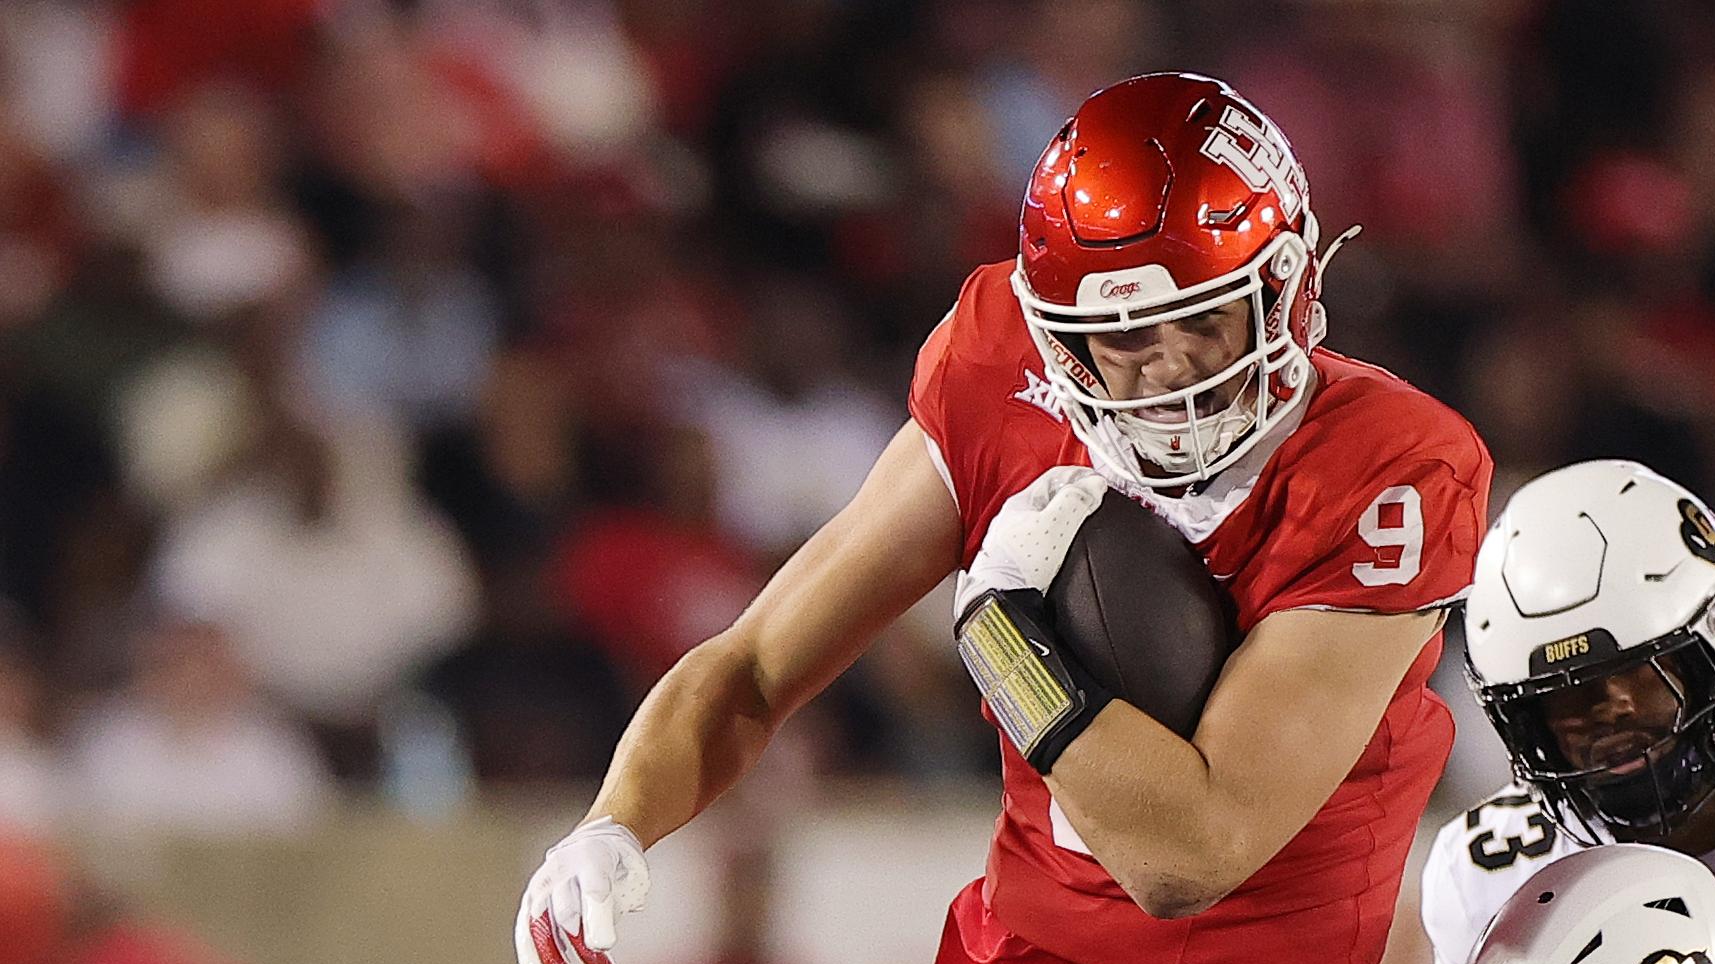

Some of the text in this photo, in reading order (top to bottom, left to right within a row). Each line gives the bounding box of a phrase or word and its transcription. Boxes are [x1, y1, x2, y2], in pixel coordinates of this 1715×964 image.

[1100, 279, 1142, 300] Coogs
[1351, 485, 1424, 587] 9
[1545, 634, 1590, 663] BUFFS
